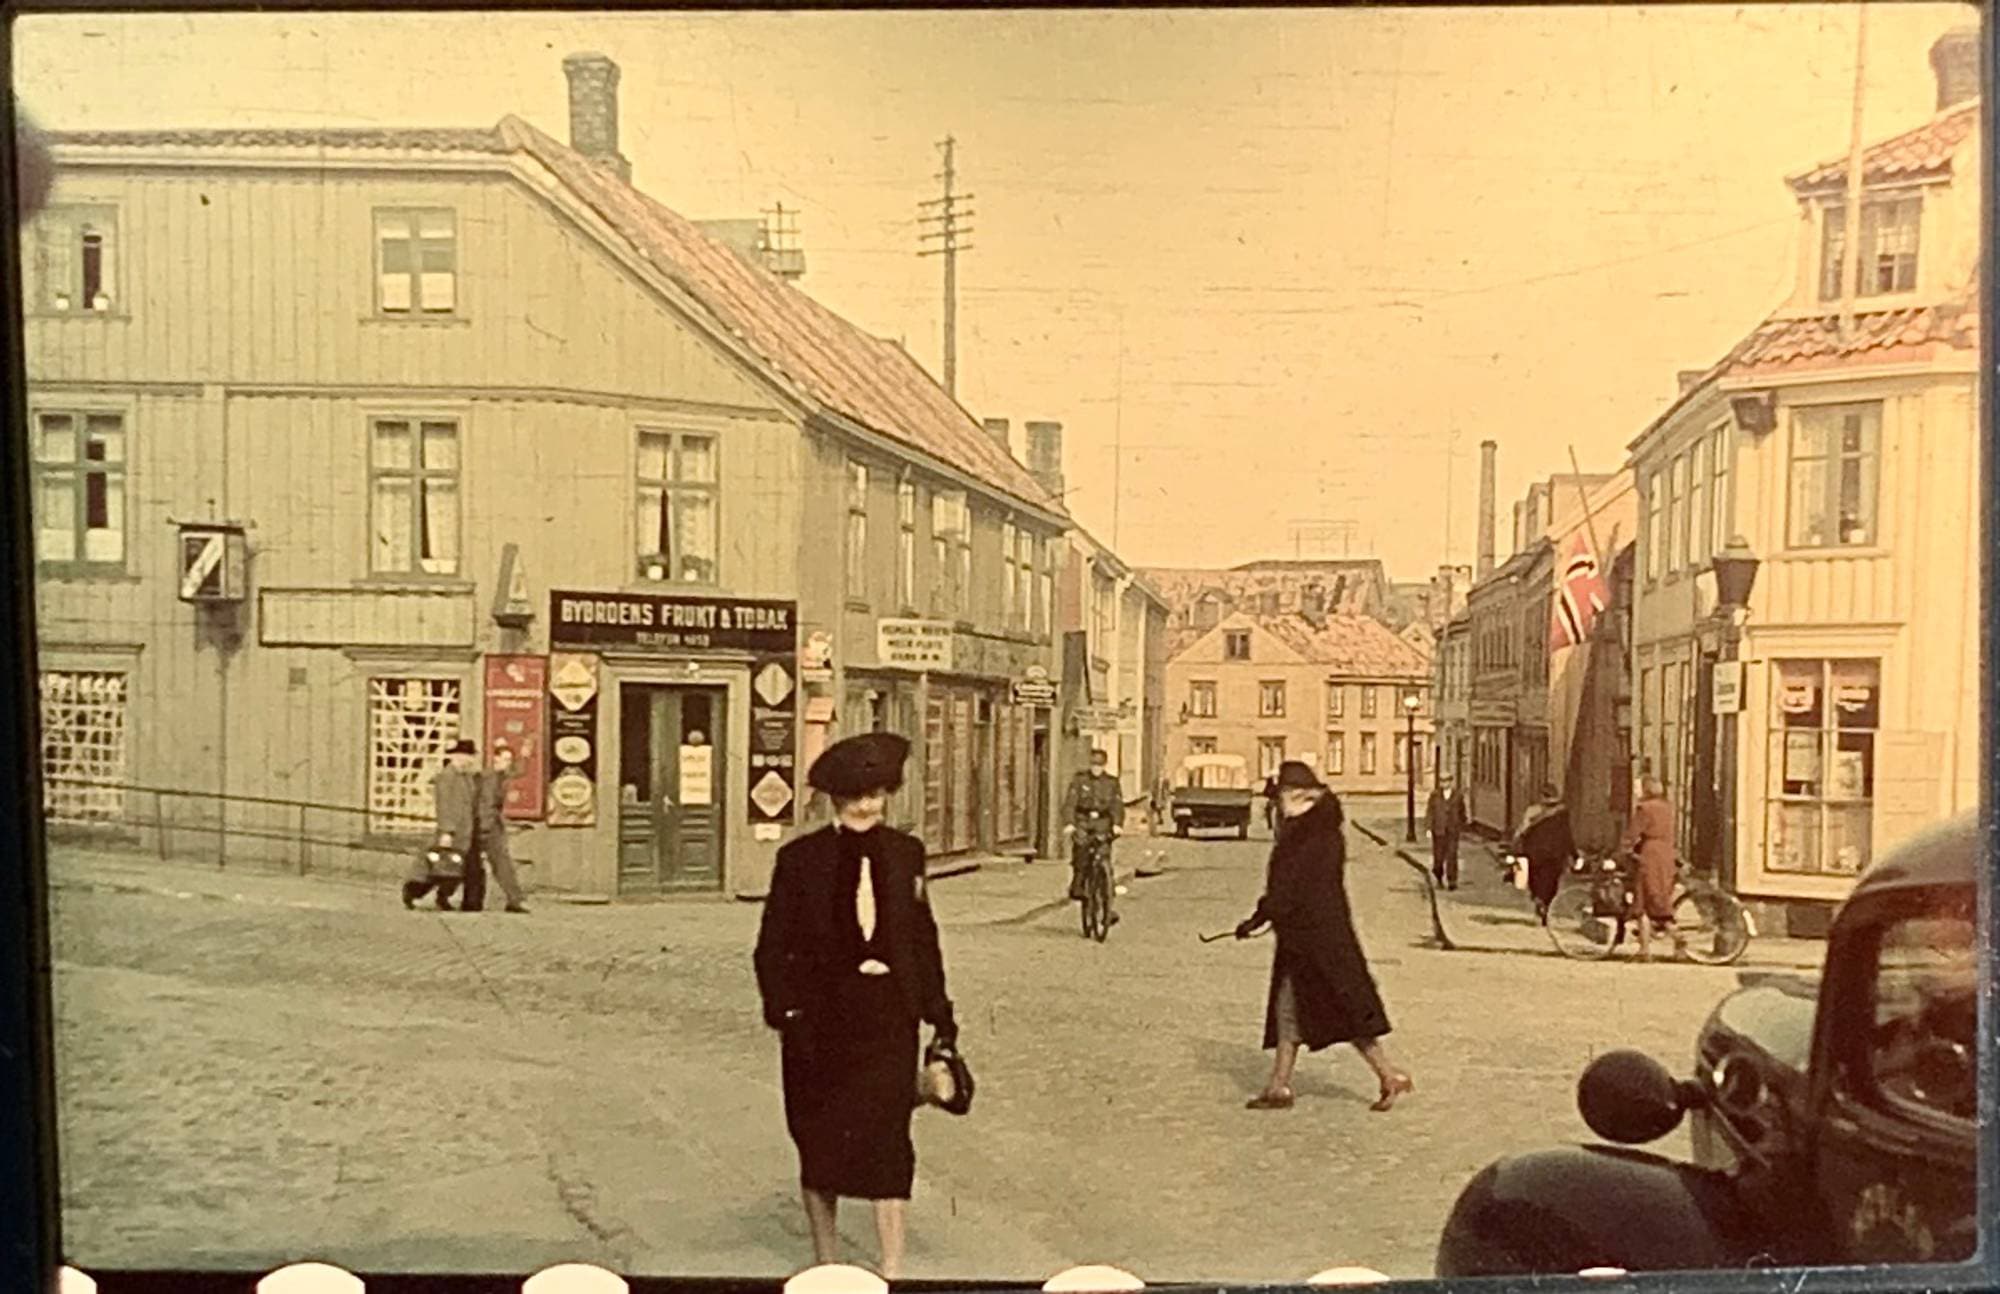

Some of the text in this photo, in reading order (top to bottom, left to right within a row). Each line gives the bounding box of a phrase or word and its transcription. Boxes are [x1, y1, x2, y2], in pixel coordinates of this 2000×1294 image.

[561, 599, 788, 630] BYBROENS FRUKT & TOBAK
